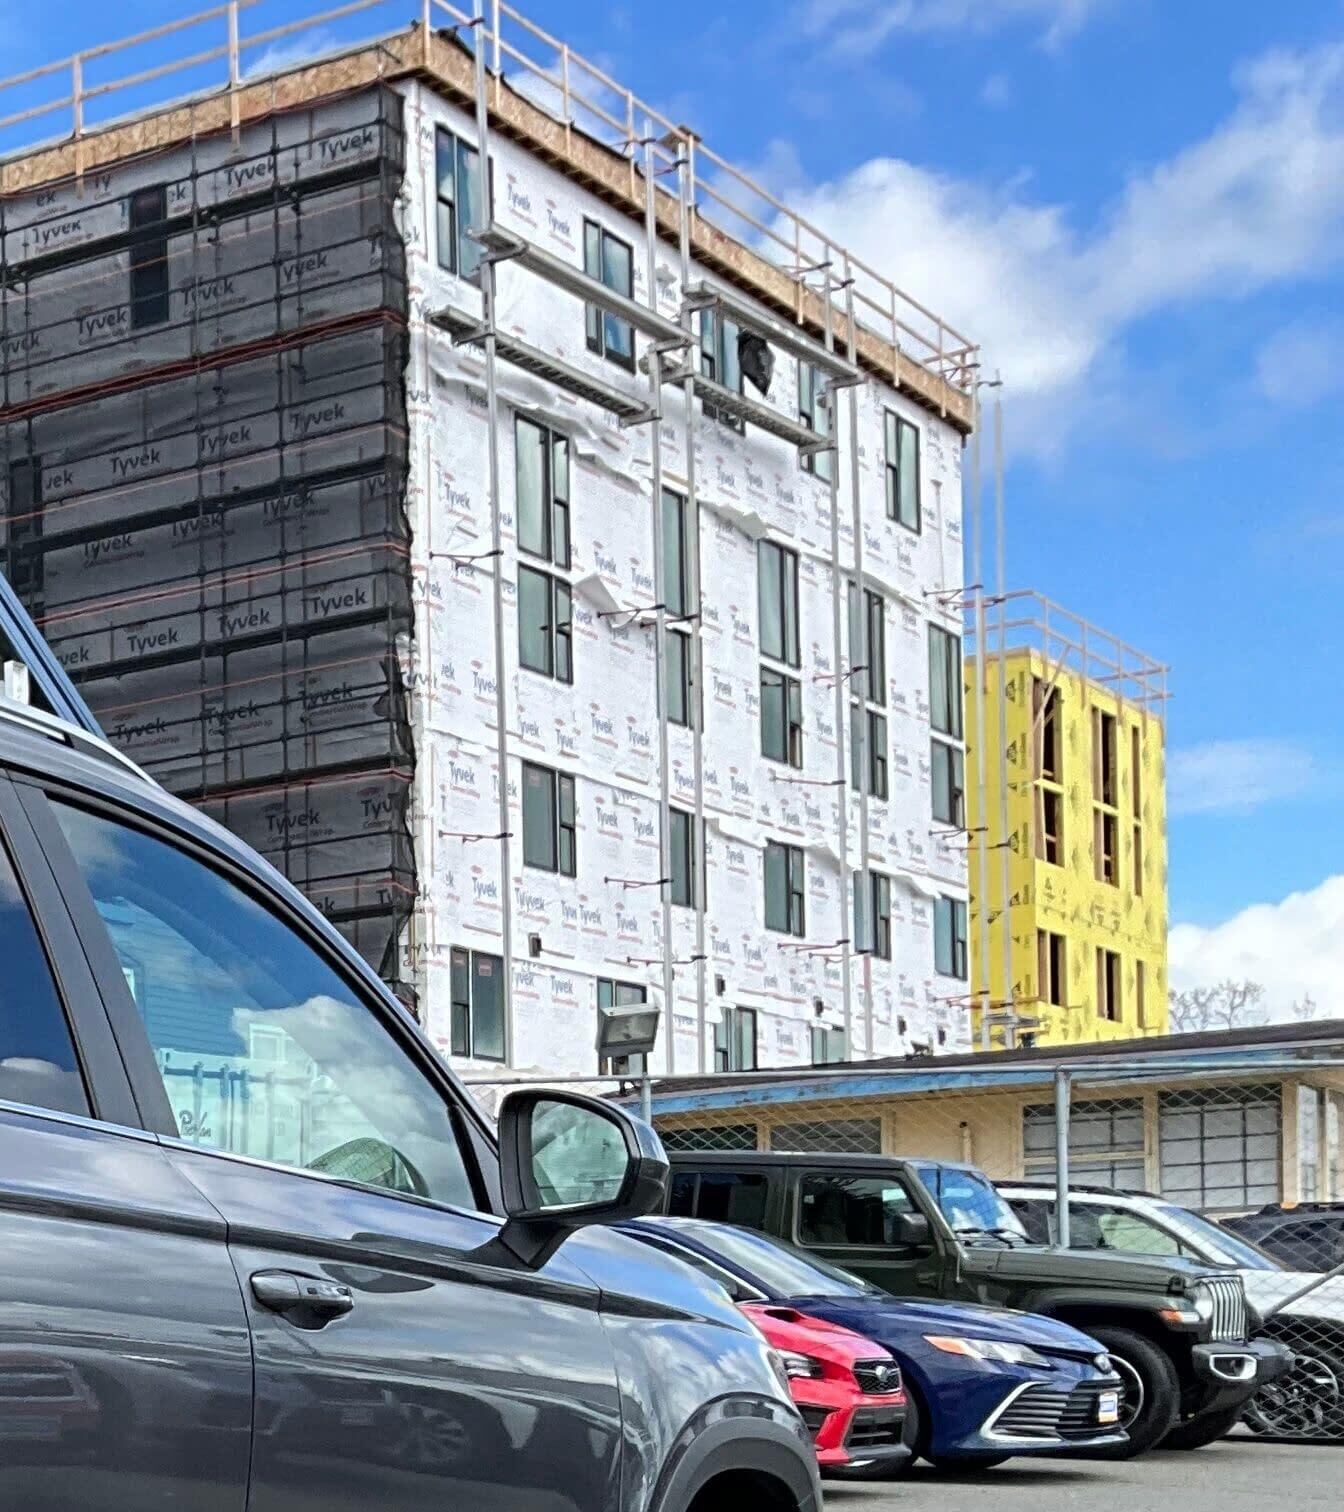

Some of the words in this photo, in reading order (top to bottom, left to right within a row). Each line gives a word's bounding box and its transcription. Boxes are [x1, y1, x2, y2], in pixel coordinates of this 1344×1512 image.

[318, 130, 374, 159] Tyvek
[224, 157, 276, 187] Tyvek
[33, 218, 81, 245] Tyvek
[282, 252, 328, 282] yvek
[76, 310, 127, 337] Tyvek
[289, 403, 345, 431] Tyvek
[198, 425, 251, 452] Tyvek
[110, 448, 161, 476] Tyvek
[84, 533, 133, 557] Tyvek
[312, 589, 367, 617] Tyvek
[218, 609, 270, 636] Tyvek
[126, 628, 178, 656] Tyvek
[449, 760, 476, 785] Tyvek
[265, 809, 320, 836] Tyvek
[362, 798, 393, 820] Tyv
